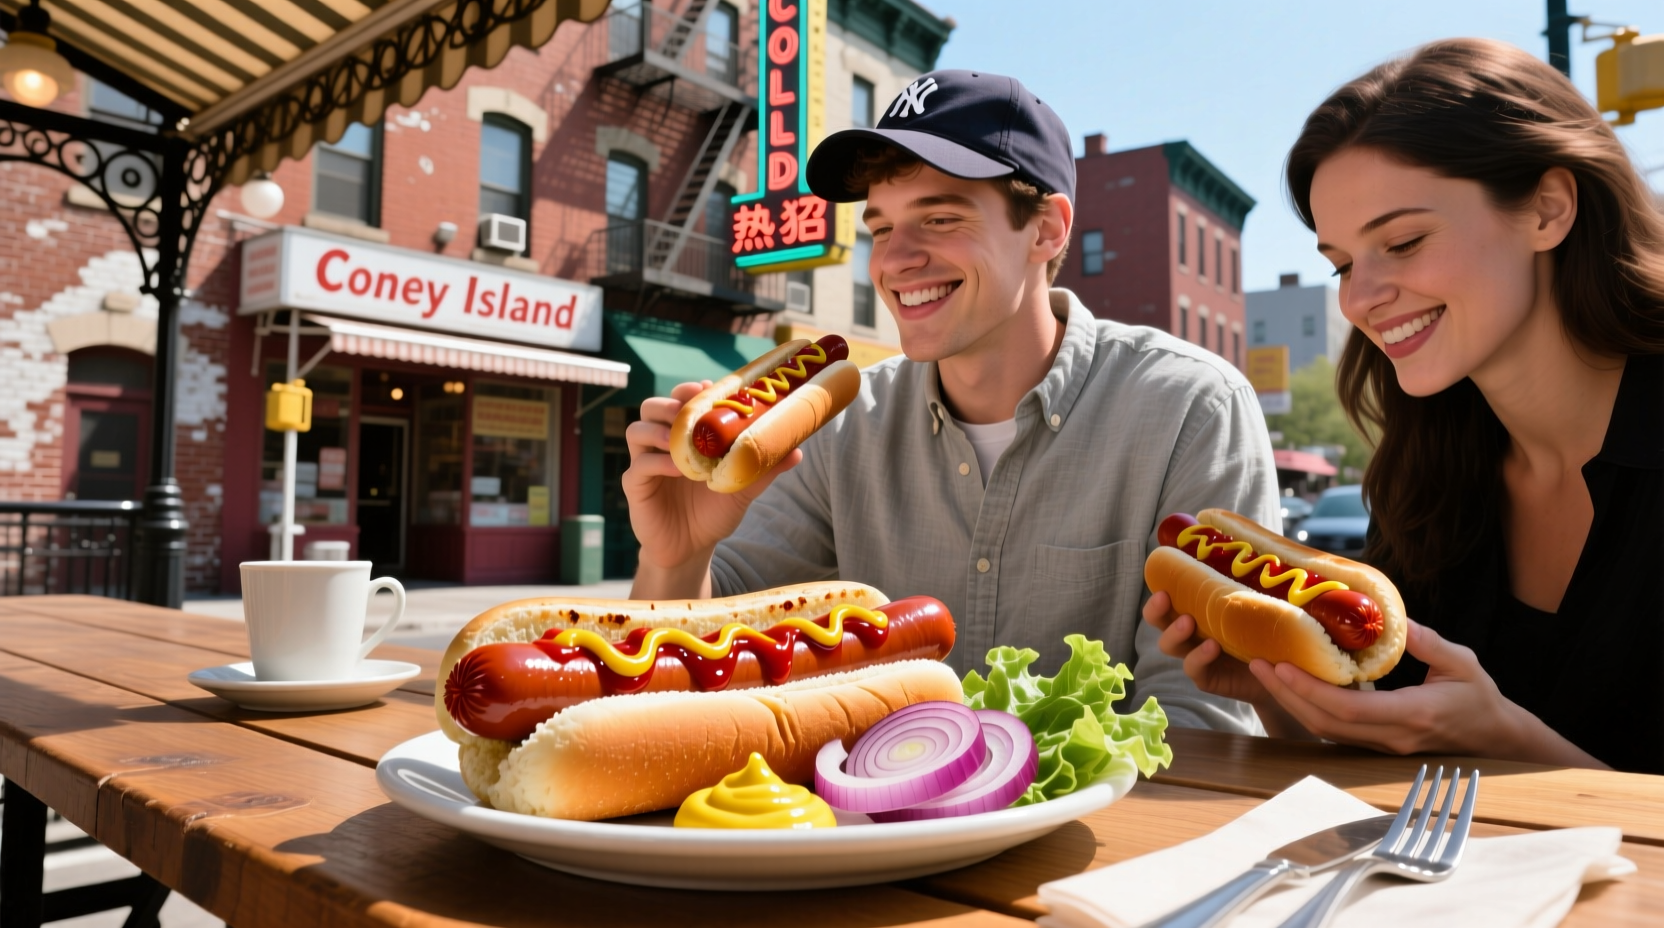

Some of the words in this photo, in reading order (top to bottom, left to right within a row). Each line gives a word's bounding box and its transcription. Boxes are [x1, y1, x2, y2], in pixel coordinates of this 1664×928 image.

[889, 77, 938, 118] NY
[316, 249, 449, 319] Coney
[463, 276, 578, 330] Island
